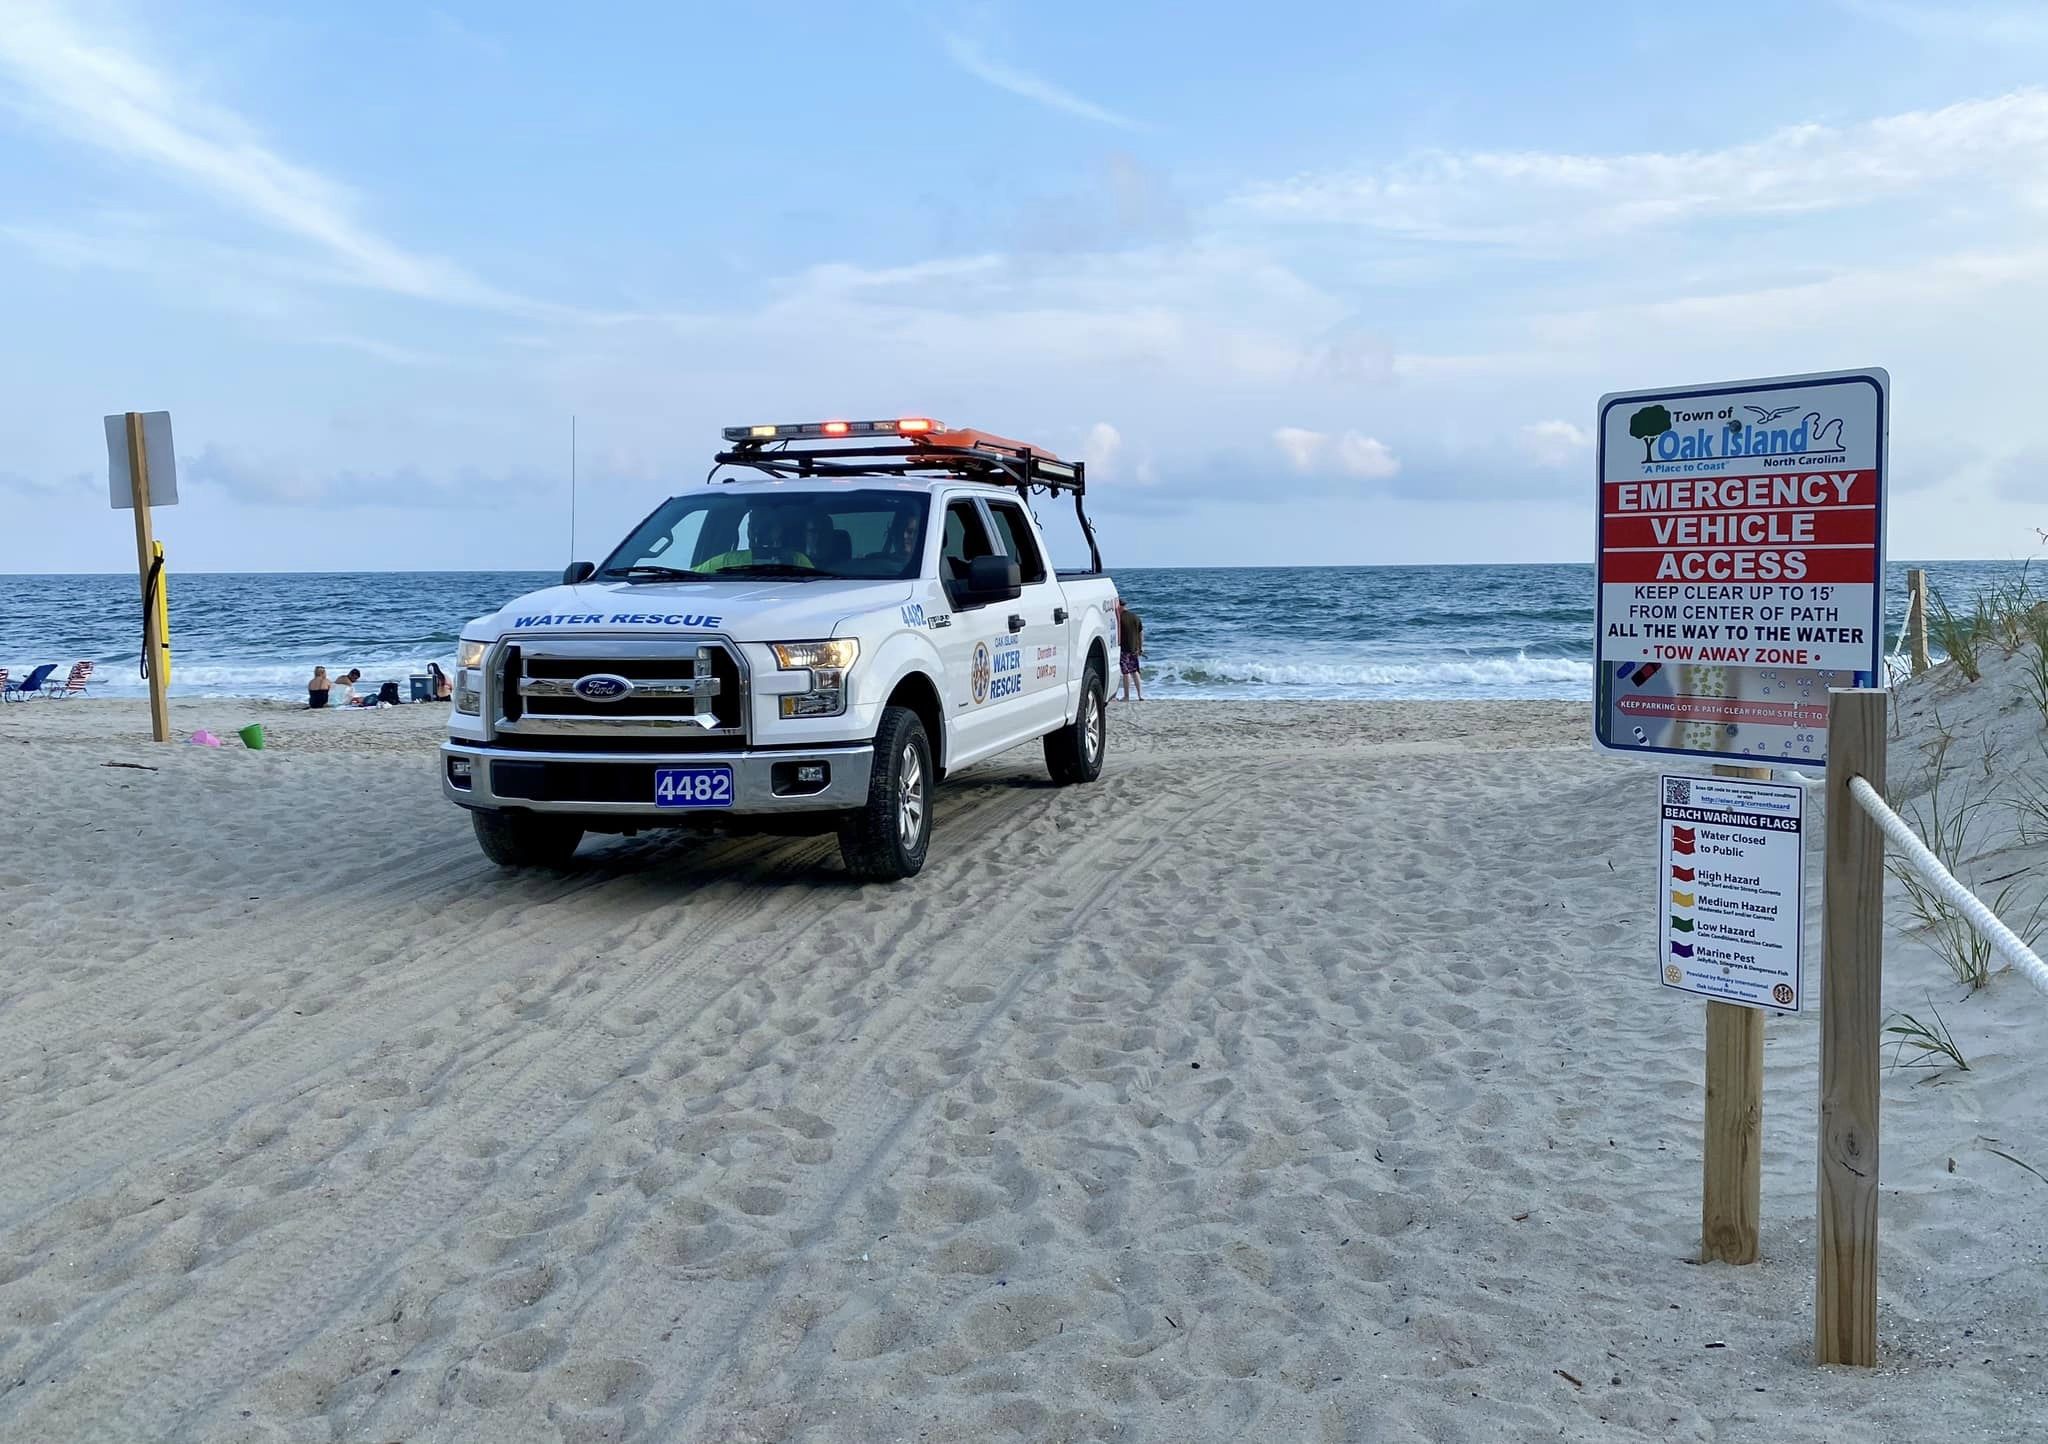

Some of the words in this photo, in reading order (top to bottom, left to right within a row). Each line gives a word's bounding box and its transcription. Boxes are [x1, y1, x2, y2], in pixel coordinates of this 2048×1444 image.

[1673, 409, 1715, 423] Town
[1718, 406, 1733, 420] of
[1657, 428, 1713, 460] Oak
[1722, 420, 1808, 457] Island
[1655, 463, 1681, 473] Place
[1683, 463, 1694, 472] to
[1763, 457, 1796, 468] North
[1799, 454, 1846, 466] Carolina
[1618, 473, 1858, 511] EMERGENCY
[1651, 513, 1816, 545] VEHICLE
[1656, 551, 1808, 580] ACCESS
[1634, 586, 1679, 600] KEEP
[1684, 586, 1744, 600] CLEAR
[1750, 586, 1774, 600] UP
[1779, 586, 1804, 601] TO
[514, 614, 604, 628] WATER
[609, 613, 723, 629] RESCUE
[901, 603, 927, 628] 4482
[1629, 605, 1677, 619] FROM
[1683, 605, 1754, 620] CENTER
[1760, 607, 1784, 621] OF
[1791, 607, 1838, 622] PATH
[1608, 623, 1638, 637] ALL
[1645, 624, 1677, 639] THE
[1682, 625, 1720, 640] WAY
[1725, 626, 1748, 641] TO
[1755, 626, 1791, 642] THE
[1796, 627, 1864, 644] WATER
[993, 650, 1020, 673] WATER
[1654, 645, 1693, 660] TOW
[1698, 647, 1750, 662] AWAY
[1755, 648, 1808, 664] ZONE
[585, 679, 617, 696] Ford
[990, 674, 1022, 699] RESCUE
[1620, 701, 1640, 709] KEEP
[1642, 702, 1675, 711] PARKING
[1677, 704, 1692, 712] LOT
[1702, 705, 1721, 714] PATH
[1723, 707, 1750, 716] CLEAR
[1752, 708, 1775, 717] FROM
[1777, 710, 1809, 720] STREET
[1812, 712, 1823, 720] TO
[657, 775, 730, 801] 4482
[1665, 807, 1701, 820] BEACH
[1703, 811, 1757, 827] WARNING
[1760, 817, 1797, 830] FLAGS
[1700, 830, 1730, 841] Water
[1732, 833, 1766, 845] Closed
[1700, 845, 1711, 853] to
[1713, 846, 1744, 857] Public
[1698, 870, 1721, 882] High
[1724, 873, 1760, 886] Hazard
[1698, 896, 1739, 909] Medium
[1741, 901, 1778, 914] Hazard
[1697, 921, 1717, 931] Low
[1719, 926, 1756, 938] Hazard
[1697, 946, 1731, 959] Marine
[1733, 952, 1755, 964] Pest
